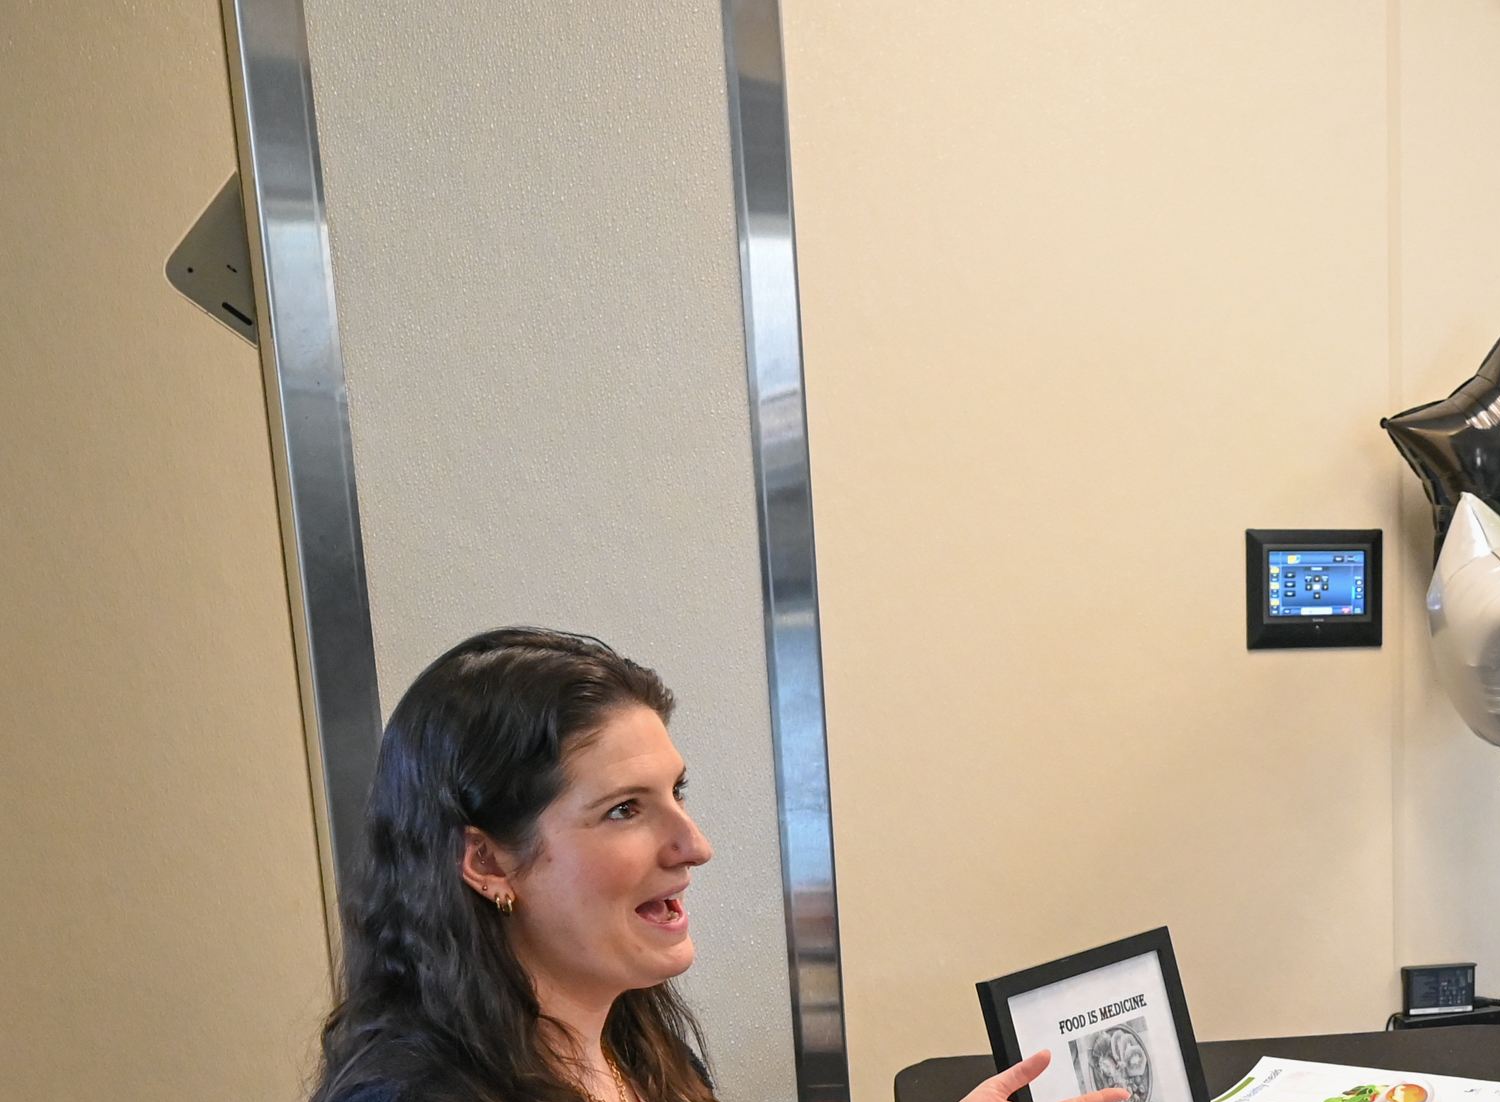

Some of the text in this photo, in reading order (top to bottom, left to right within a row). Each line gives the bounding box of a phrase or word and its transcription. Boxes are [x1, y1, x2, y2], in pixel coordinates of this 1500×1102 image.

[1059, 994, 1147, 1034] FOOD IS MEDICINE
